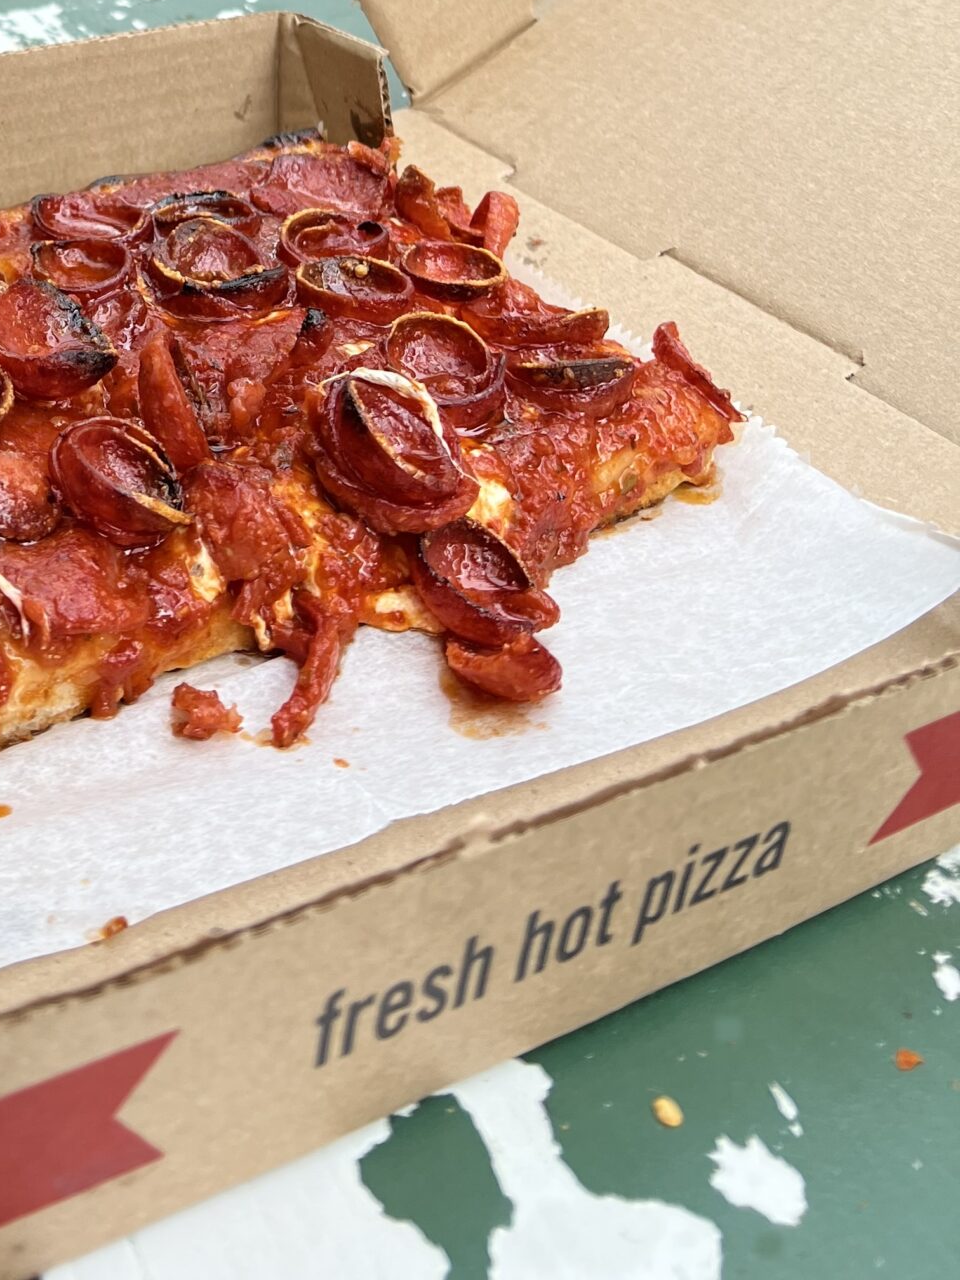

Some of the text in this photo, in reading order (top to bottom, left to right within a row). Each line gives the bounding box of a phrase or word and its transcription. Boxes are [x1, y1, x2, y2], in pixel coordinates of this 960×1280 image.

[315, 821, 790, 1068] fresh hot pizza
